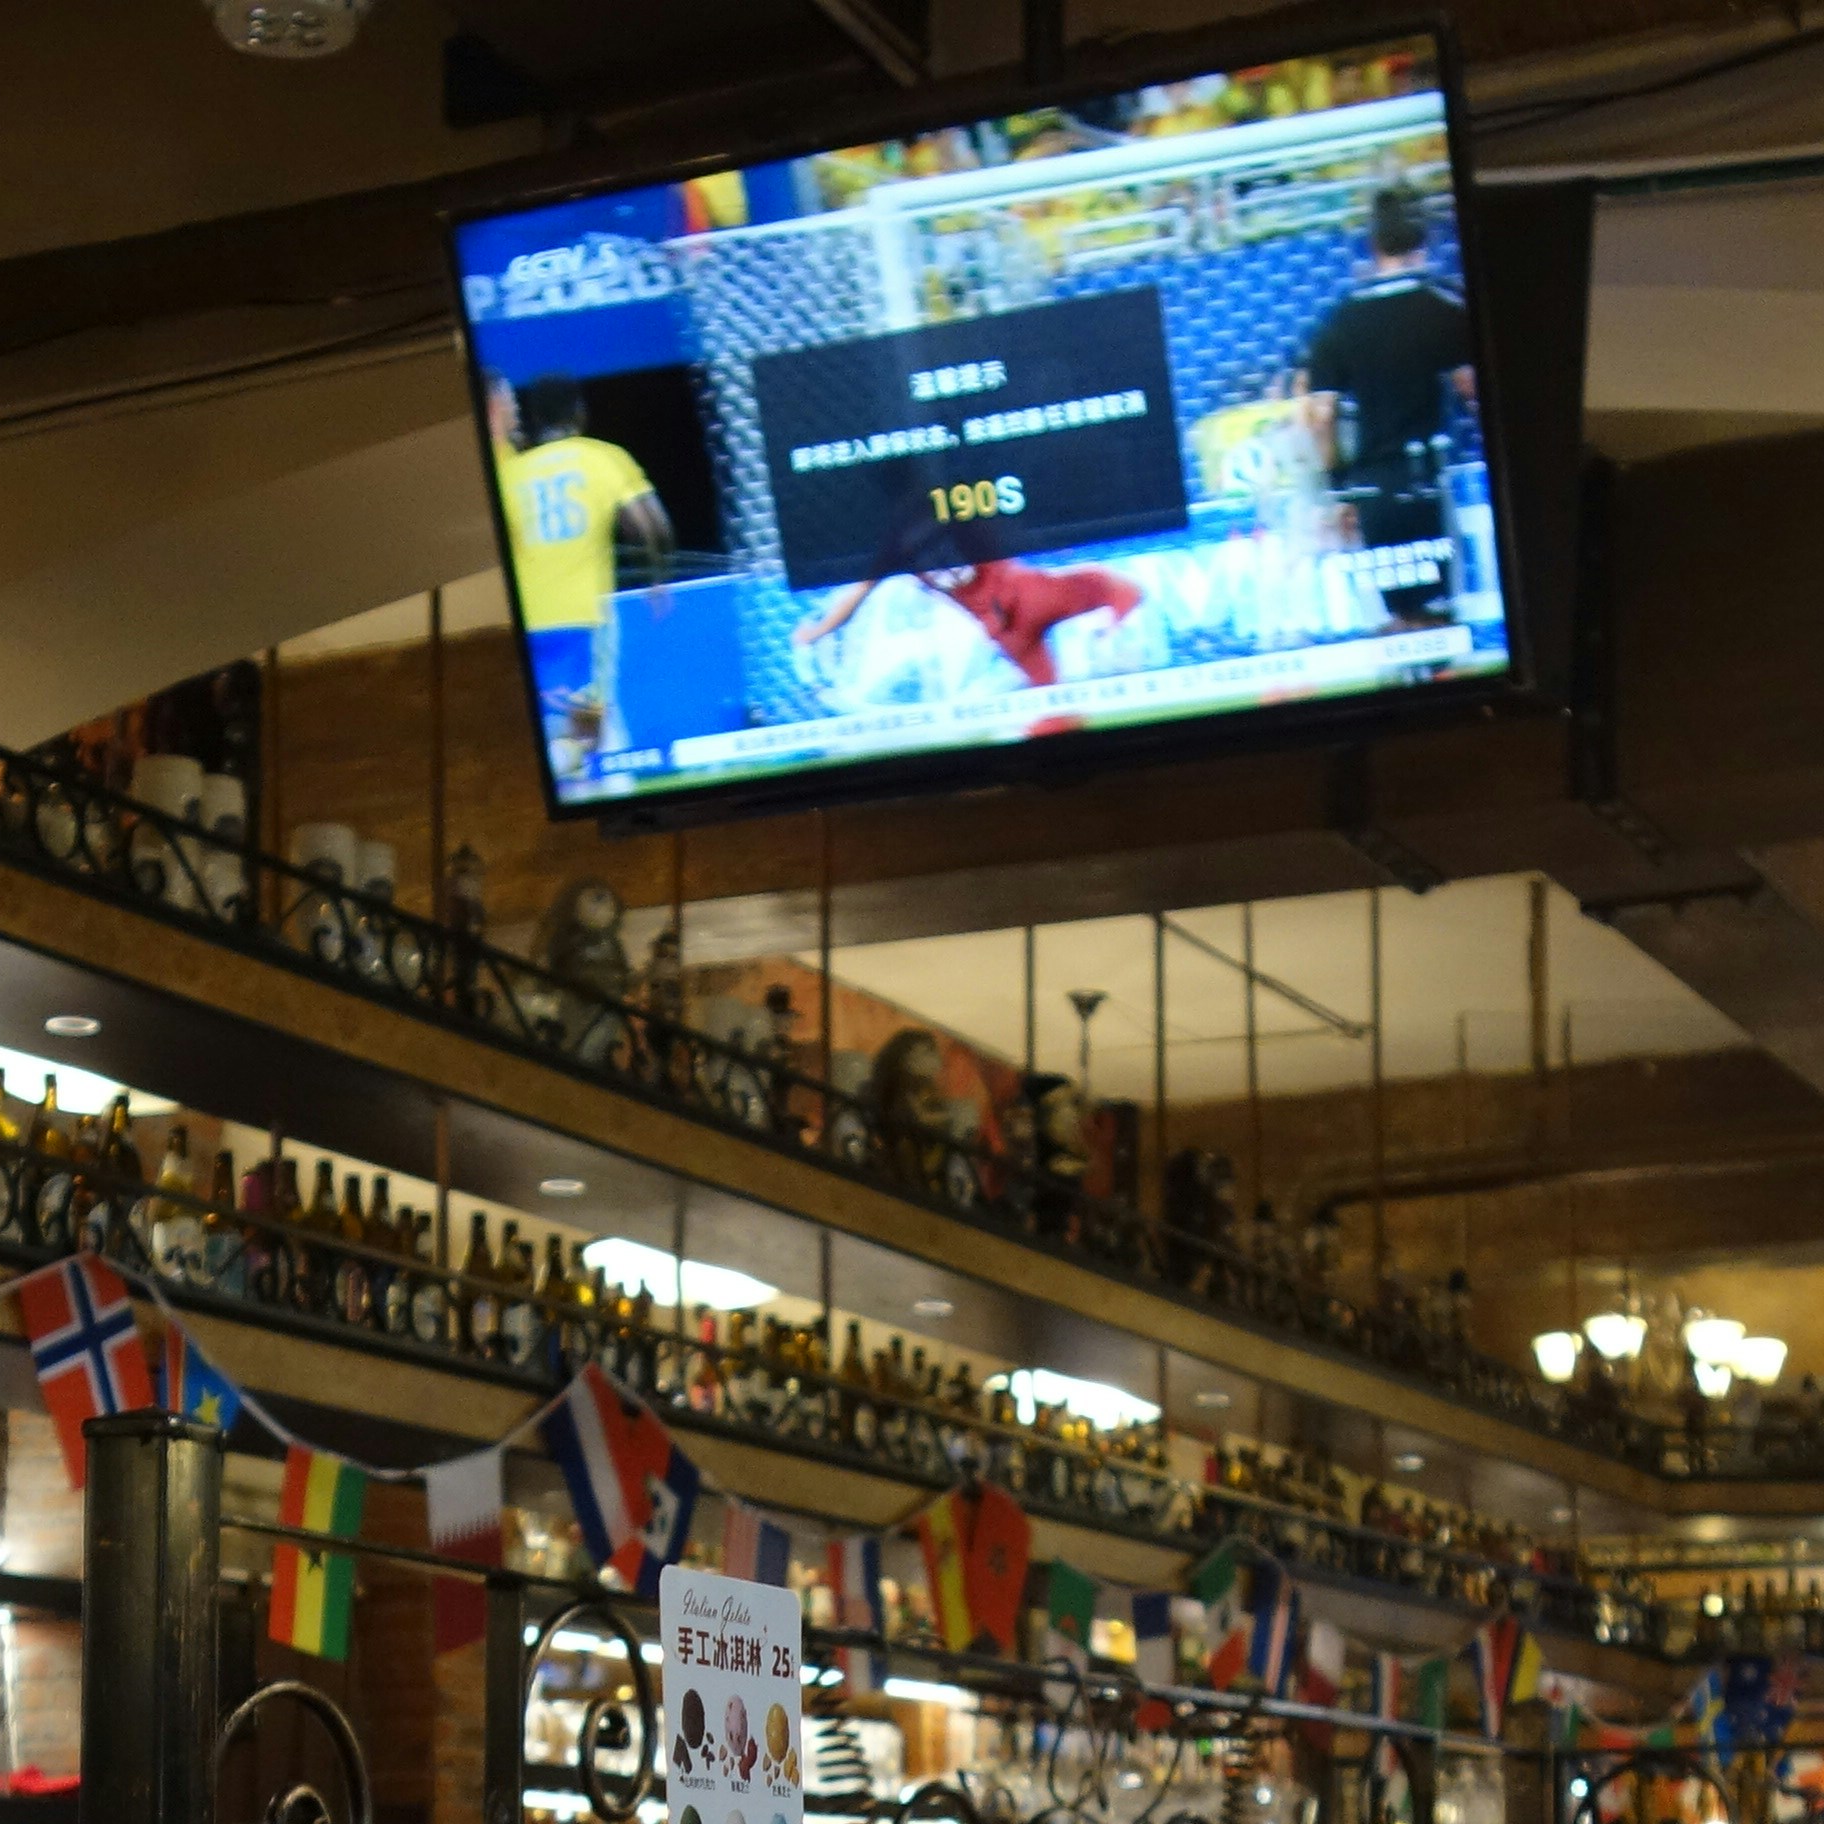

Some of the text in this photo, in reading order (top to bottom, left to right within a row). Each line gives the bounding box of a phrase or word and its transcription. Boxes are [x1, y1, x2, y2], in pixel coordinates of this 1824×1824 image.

[929, 475, 1026, 524] 190S
[683, 1588, 751, 1634] Italian Gelato
[677, 1627, 762, 1677] 手工冰淇淋
[772, 1645, 790, 1678] 25
